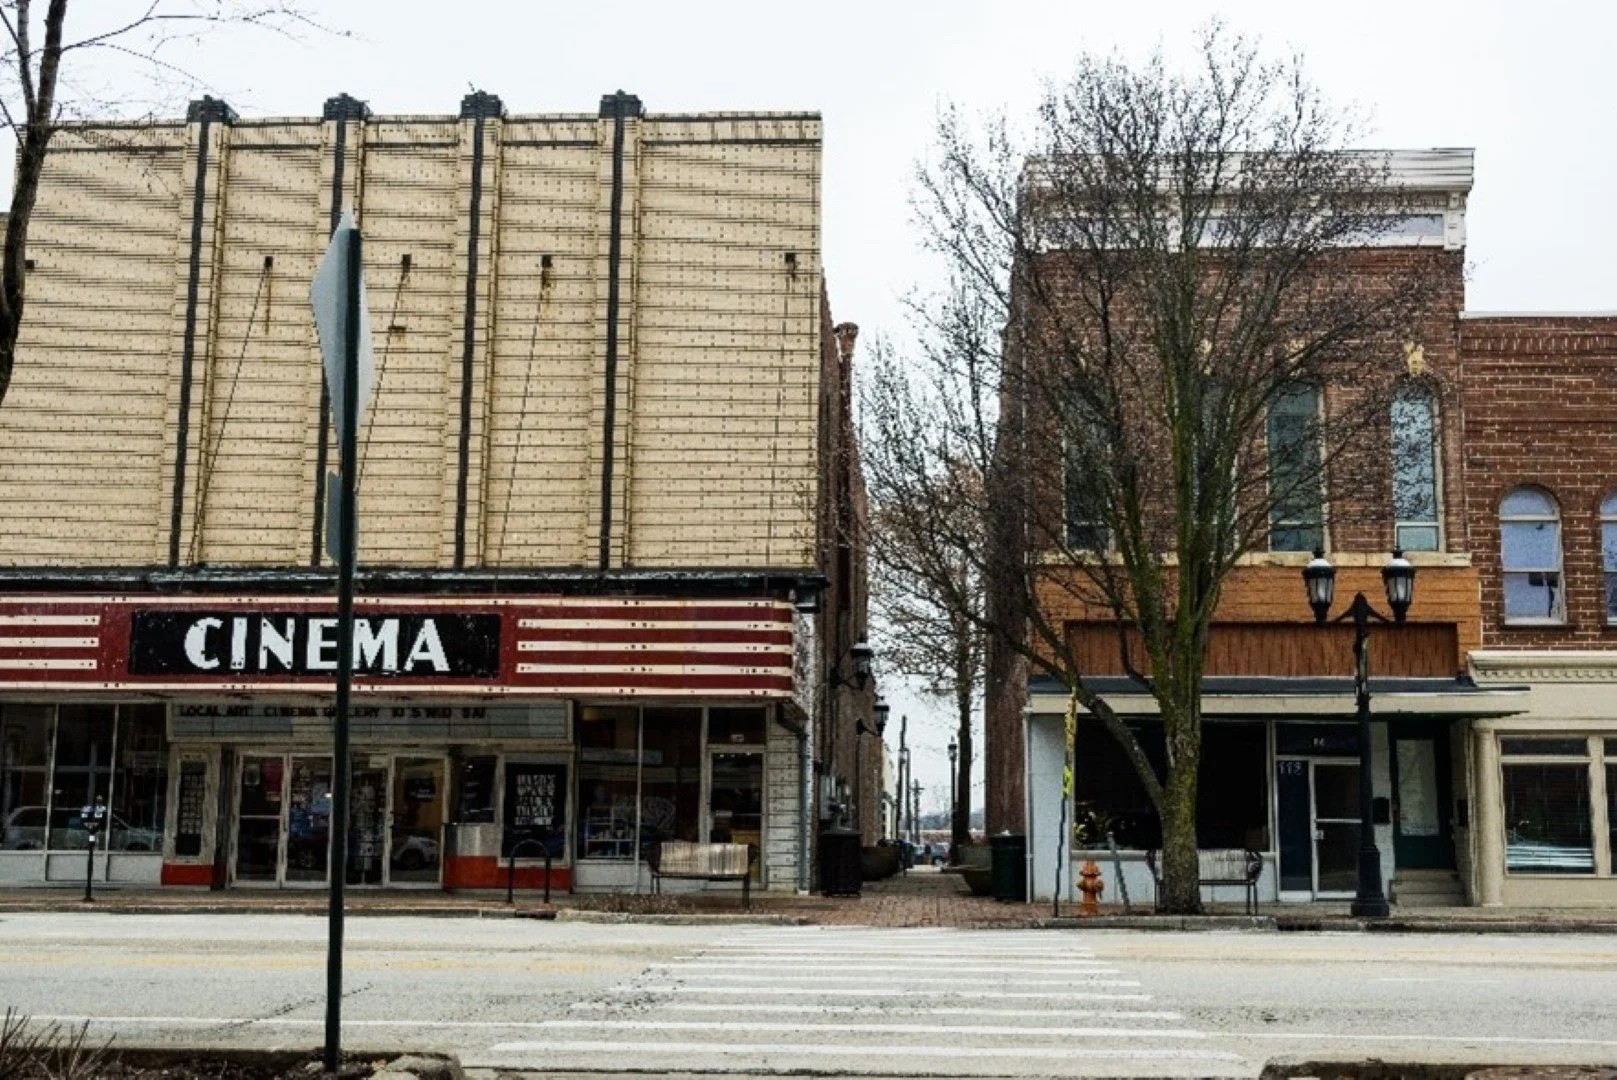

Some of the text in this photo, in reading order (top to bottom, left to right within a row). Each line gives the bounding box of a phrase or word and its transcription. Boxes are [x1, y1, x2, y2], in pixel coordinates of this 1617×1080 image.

[184, 617, 451, 672] CINEMA
[179, 704, 221, 717] LOCAL
[263, 706, 318, 717] CINEMA
